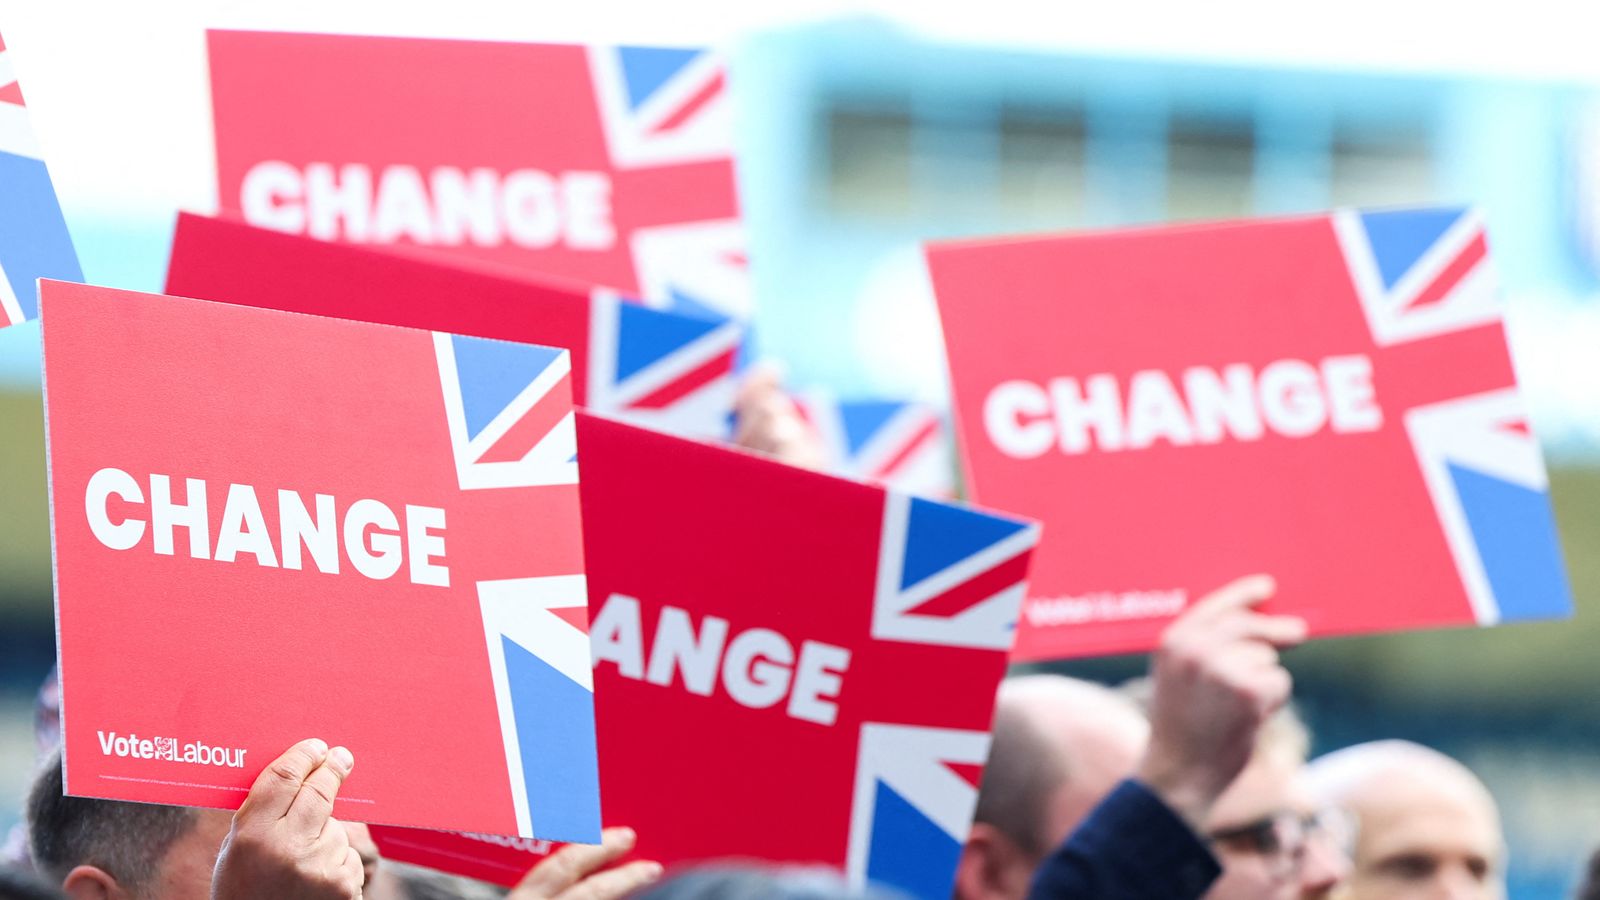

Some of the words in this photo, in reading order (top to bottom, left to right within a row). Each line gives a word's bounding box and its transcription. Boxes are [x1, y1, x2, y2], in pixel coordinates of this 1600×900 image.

[241, 161, 614, 249] CHANGE
[985, 355, 1381, 457] CHANGE
[84, 467, 451, 588] CHANGE
[592, 592, 851, 726] ANGE
[97, 730, 155, 760] Vote
[173, 737, 248, 768] Labour
